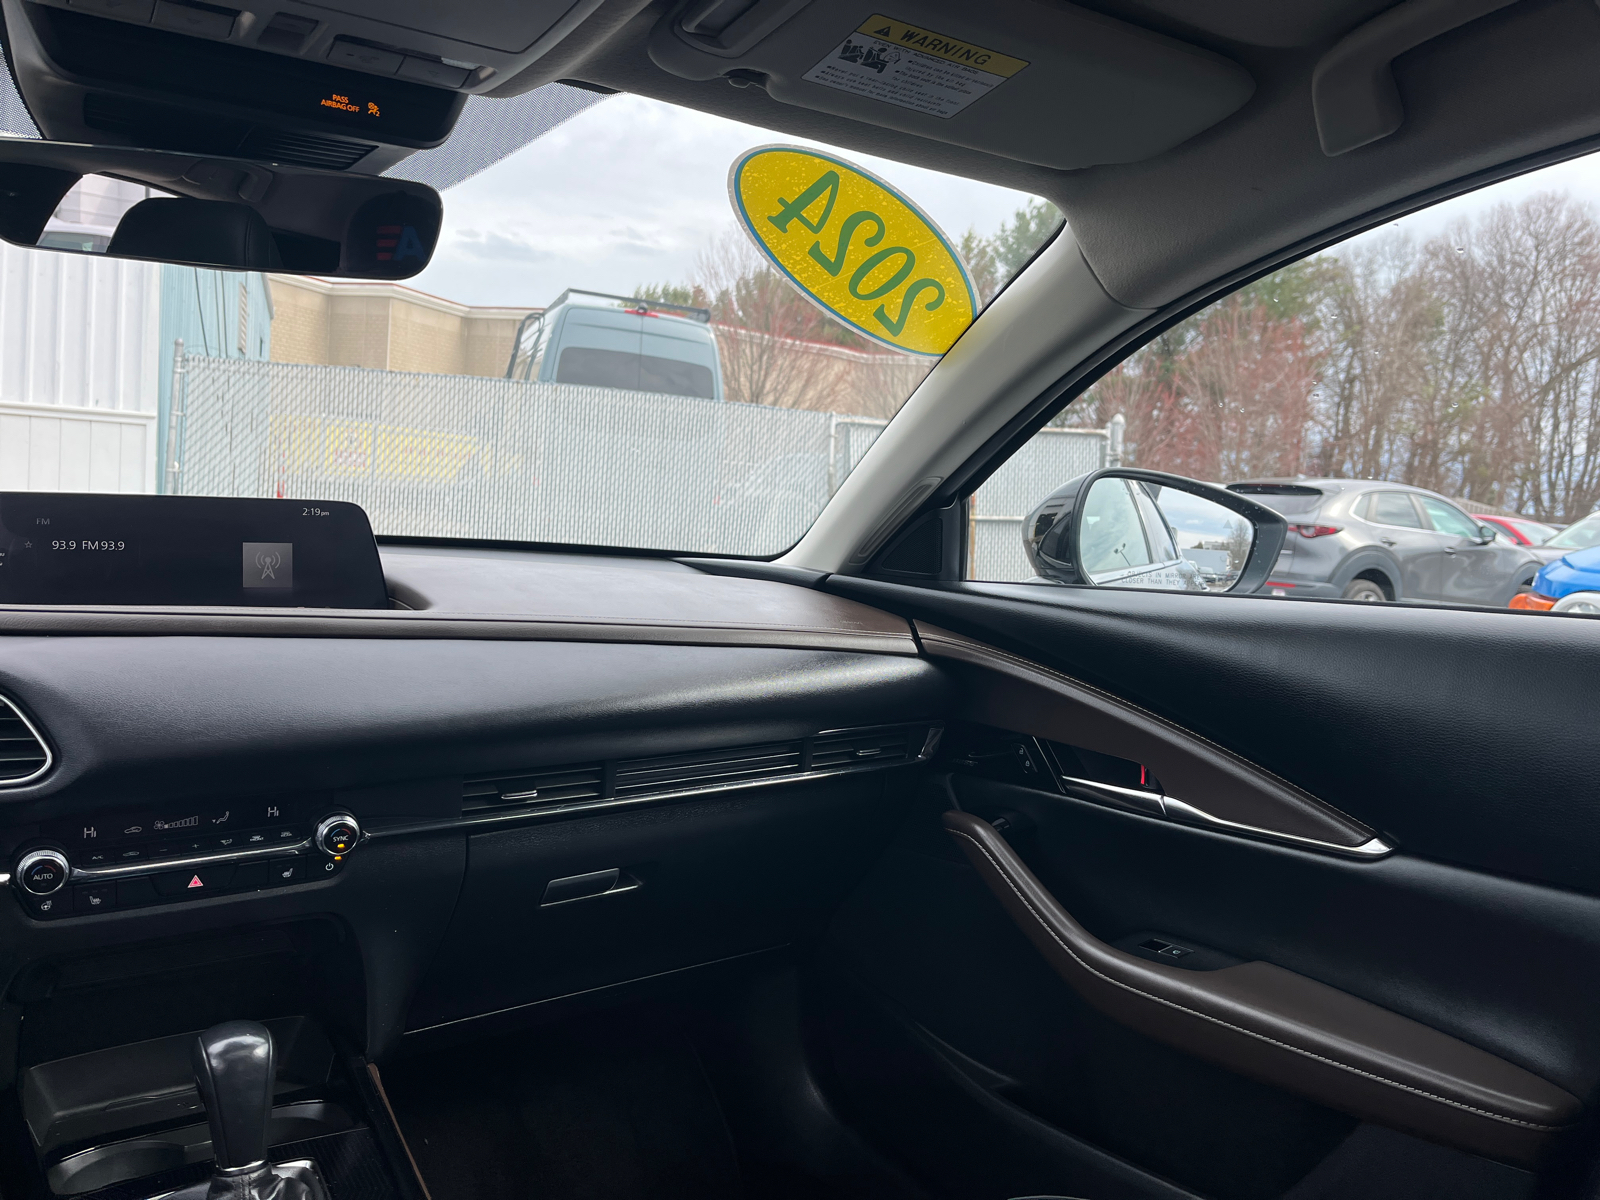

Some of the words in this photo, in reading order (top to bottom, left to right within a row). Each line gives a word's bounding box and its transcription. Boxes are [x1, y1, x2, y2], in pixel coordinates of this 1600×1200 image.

[900, 30, 991, 65] WARNING
[914, 52, 945, 64] ADVANCED
[332, 94, 349, 103] PASS
[320, 99, 347, 110] AIRBAG
[347, 104, 360, 113] OFF
[51, 540, 76, 550] 93.9
[82, 540, 99, 550] FM
[100, 541, 125, 550] 93.9
[333, 835, 349, 843] SYNC
[33, 873, 54, 881] AUTO
